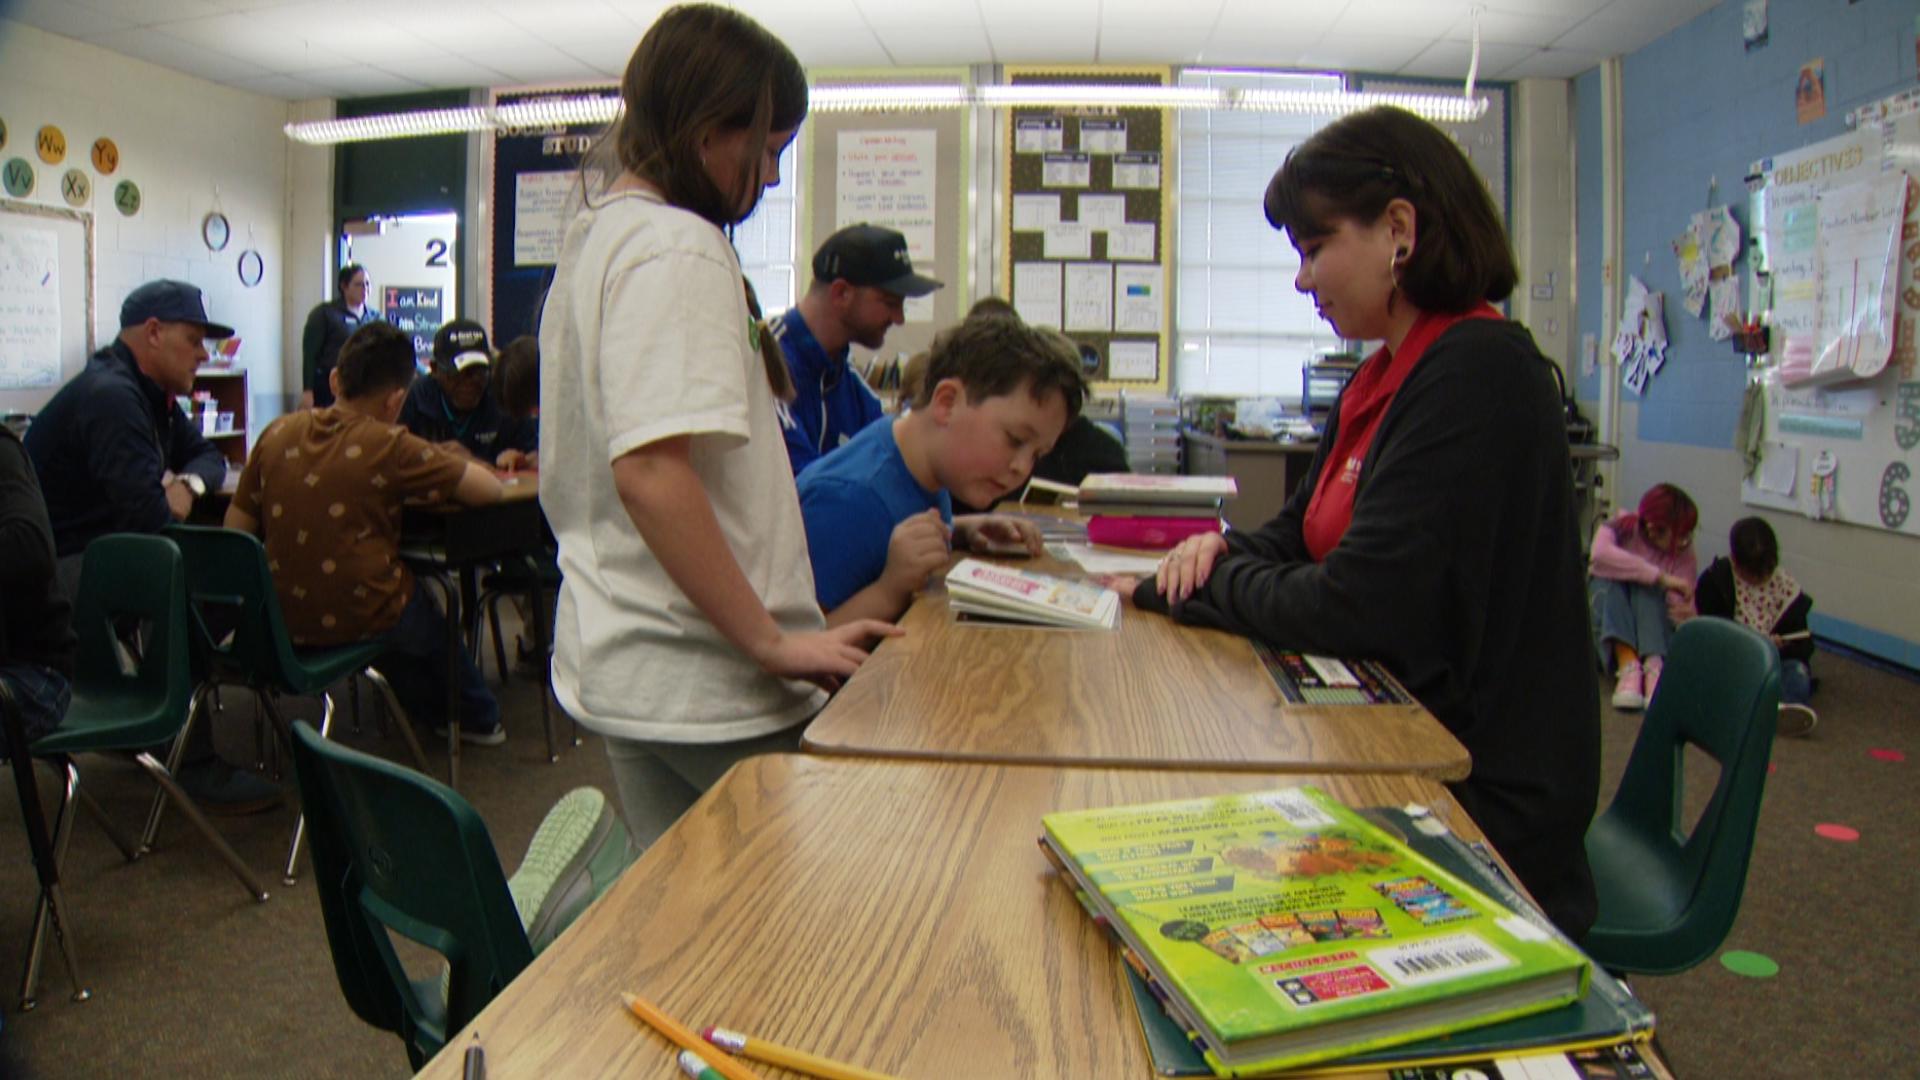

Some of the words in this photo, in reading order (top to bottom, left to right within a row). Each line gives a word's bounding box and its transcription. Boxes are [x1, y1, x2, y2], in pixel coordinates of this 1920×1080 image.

[425, 238, 447, 268] 2
[388, 288, 398, 308] I
[400, 296, 415, 308] am
[416, 289, 439, 308] Kind
[1879, 461, 1911, 530] 6
